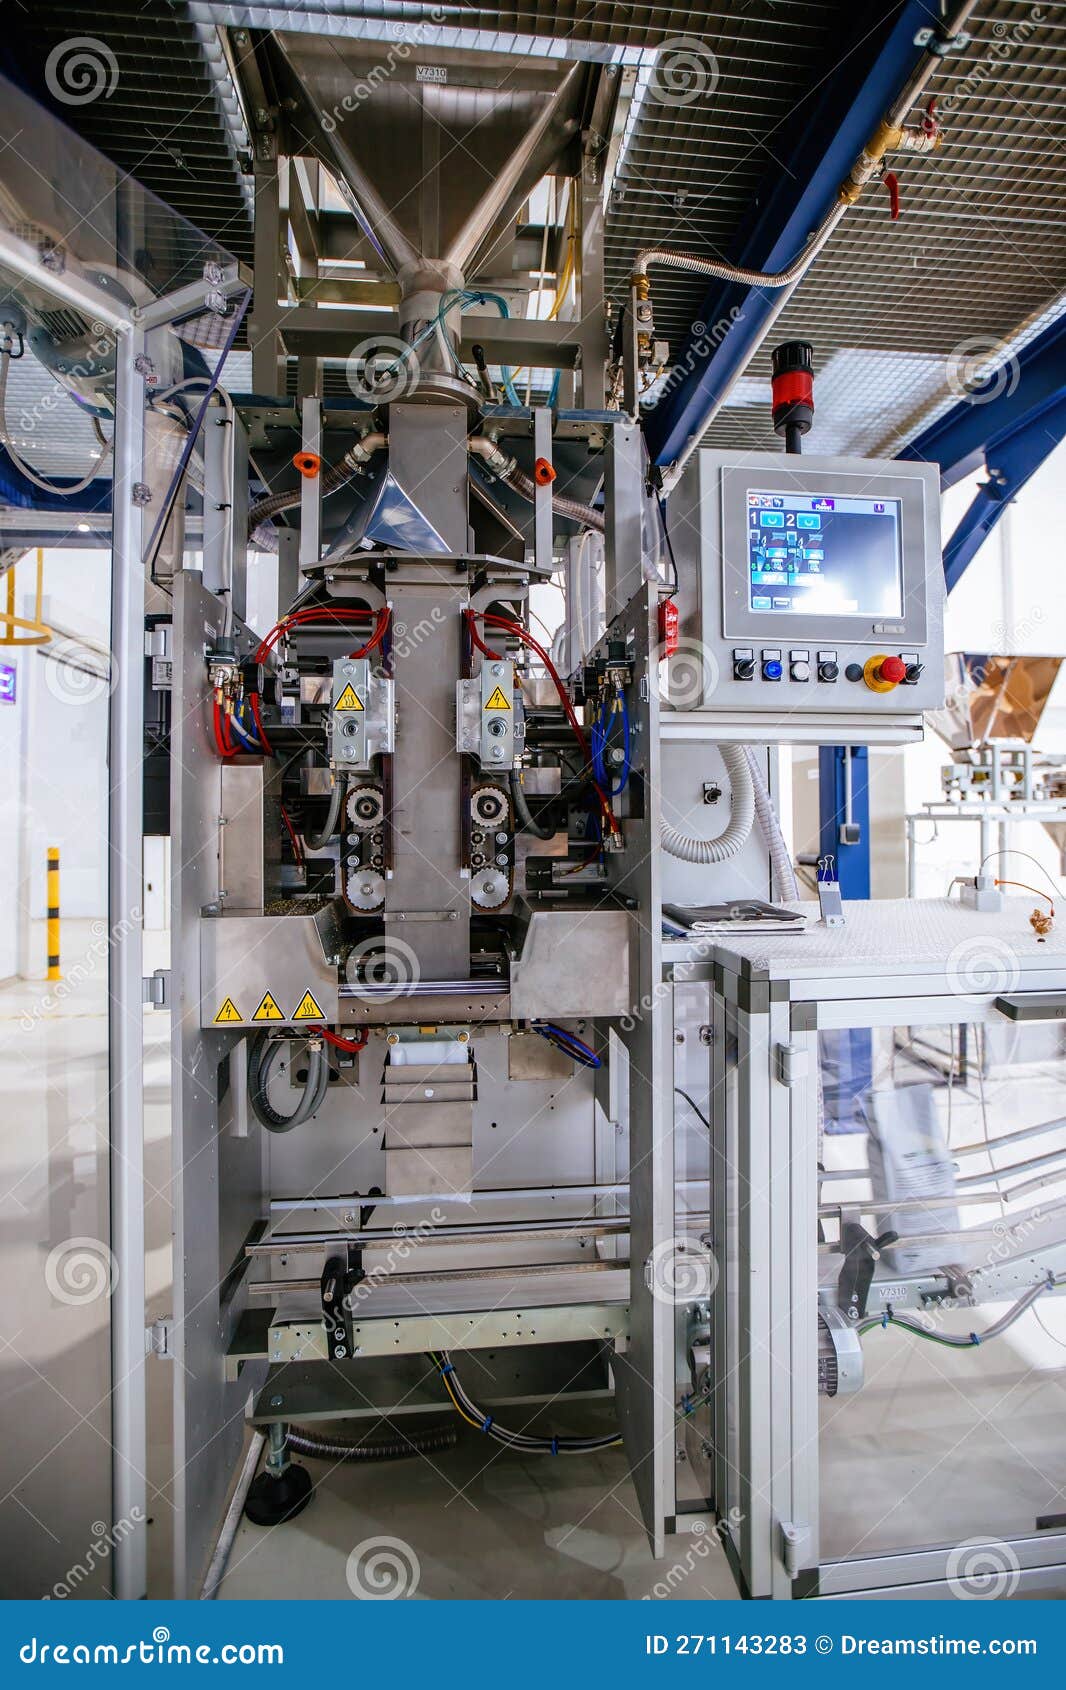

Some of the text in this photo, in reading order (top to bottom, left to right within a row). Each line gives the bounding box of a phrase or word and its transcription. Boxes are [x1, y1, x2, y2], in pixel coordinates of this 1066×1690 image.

[417, 67, 446, 77] V7310
[750, 511, 795, 527] 1 2
